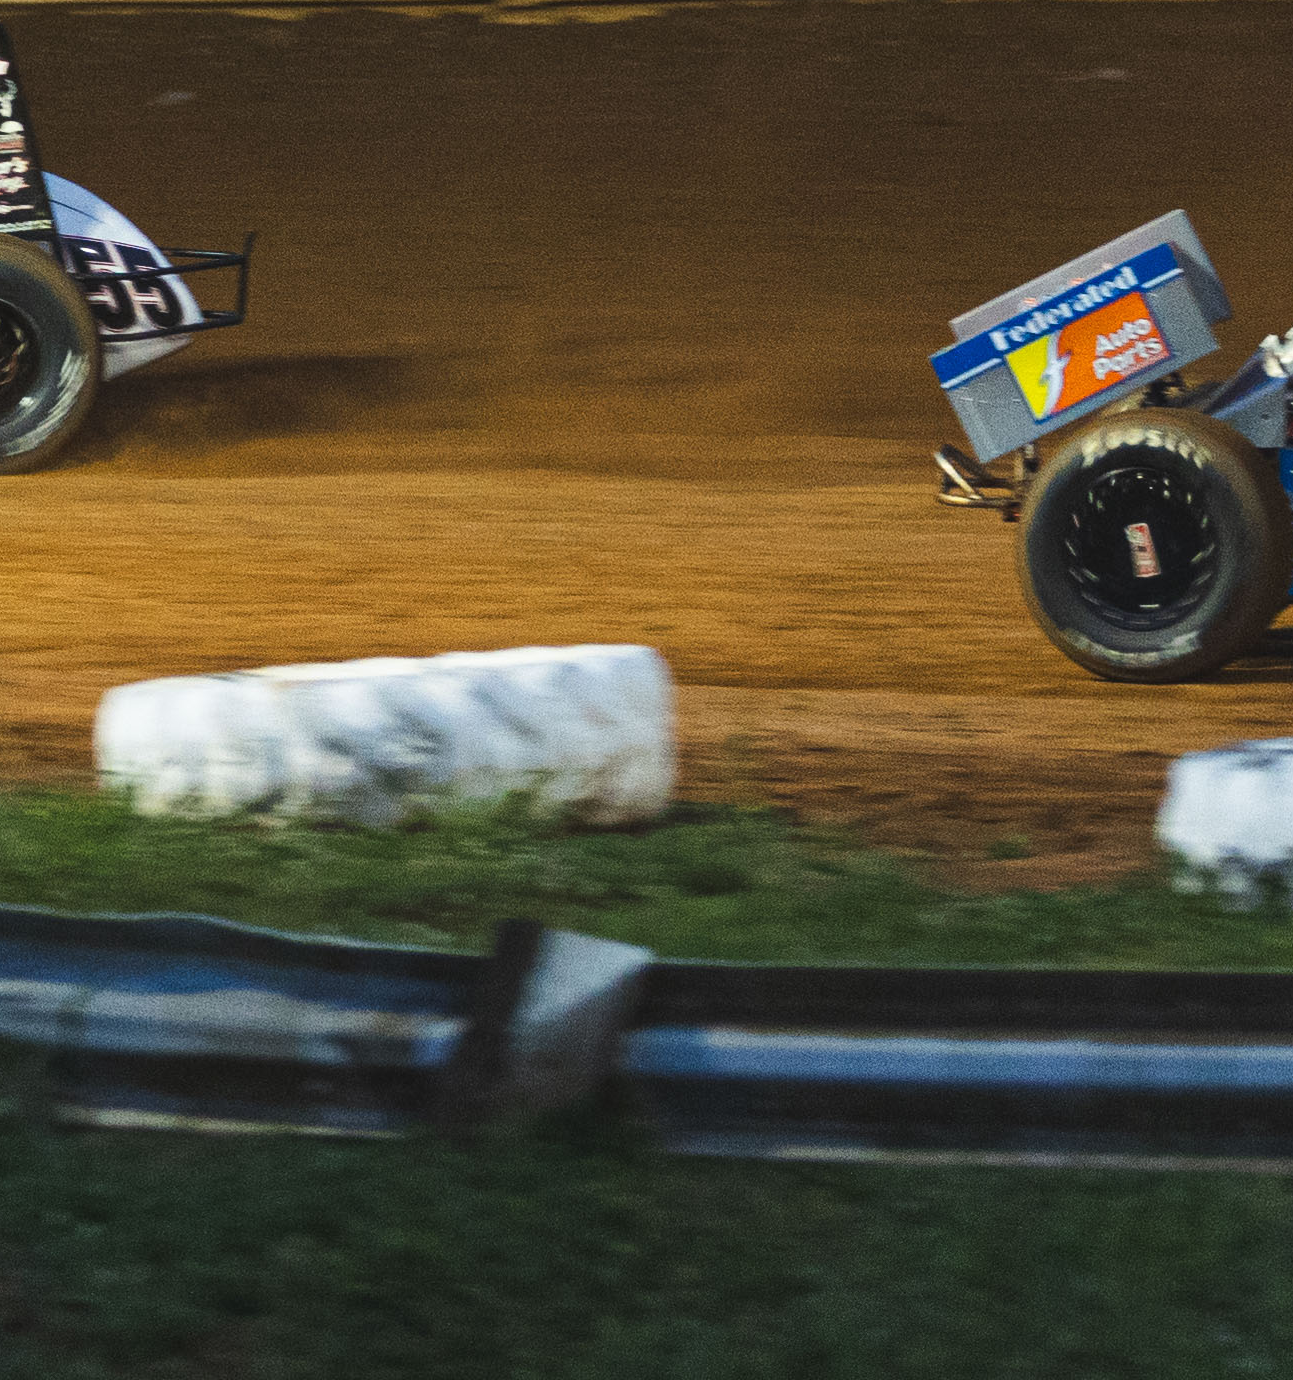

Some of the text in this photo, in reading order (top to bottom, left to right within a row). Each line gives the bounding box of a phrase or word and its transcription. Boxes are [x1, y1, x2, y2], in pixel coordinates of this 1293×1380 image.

[61, 237, 188, 330] 55
[988, 268, 1140, 352] Federated
[1093, 337, 1163, 382] Parts
[1095, 318, 1153, 354] Auto
